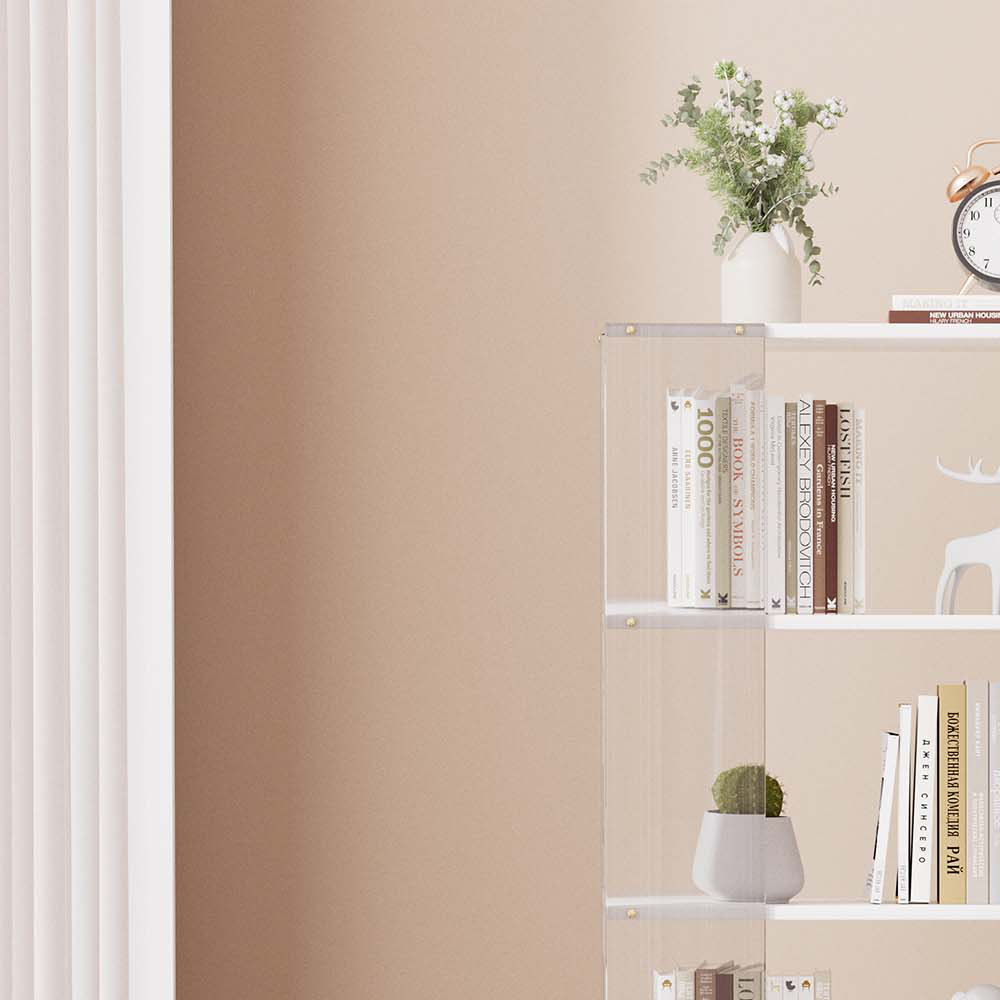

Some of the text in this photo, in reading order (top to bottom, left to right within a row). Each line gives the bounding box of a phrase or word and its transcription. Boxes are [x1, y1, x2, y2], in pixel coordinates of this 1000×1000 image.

[963, 229, 970, 239] 9
[970, 211, 980, 221] 10
[984, 198, 993, 207] 11
[968, 246, 976, 256] 8
[983, 259, 990, 269] 7
[697, 408, 714, 468] 1000
[840, 409, 851, 499] LOST FISH
[733, 437, 744, 577] BOOK SYMBOLS
[799, 399, 812, 599] ALEXEY BRODOVITCH
[816, 463, 824, 555] Gardens in France
[918, 739, 931, 864] ДЖЕН СИНСЕРО
[946, 712, 964, 875] БОЖЕСТВЕННАЯ КОМЕДИЯ РАЙ
